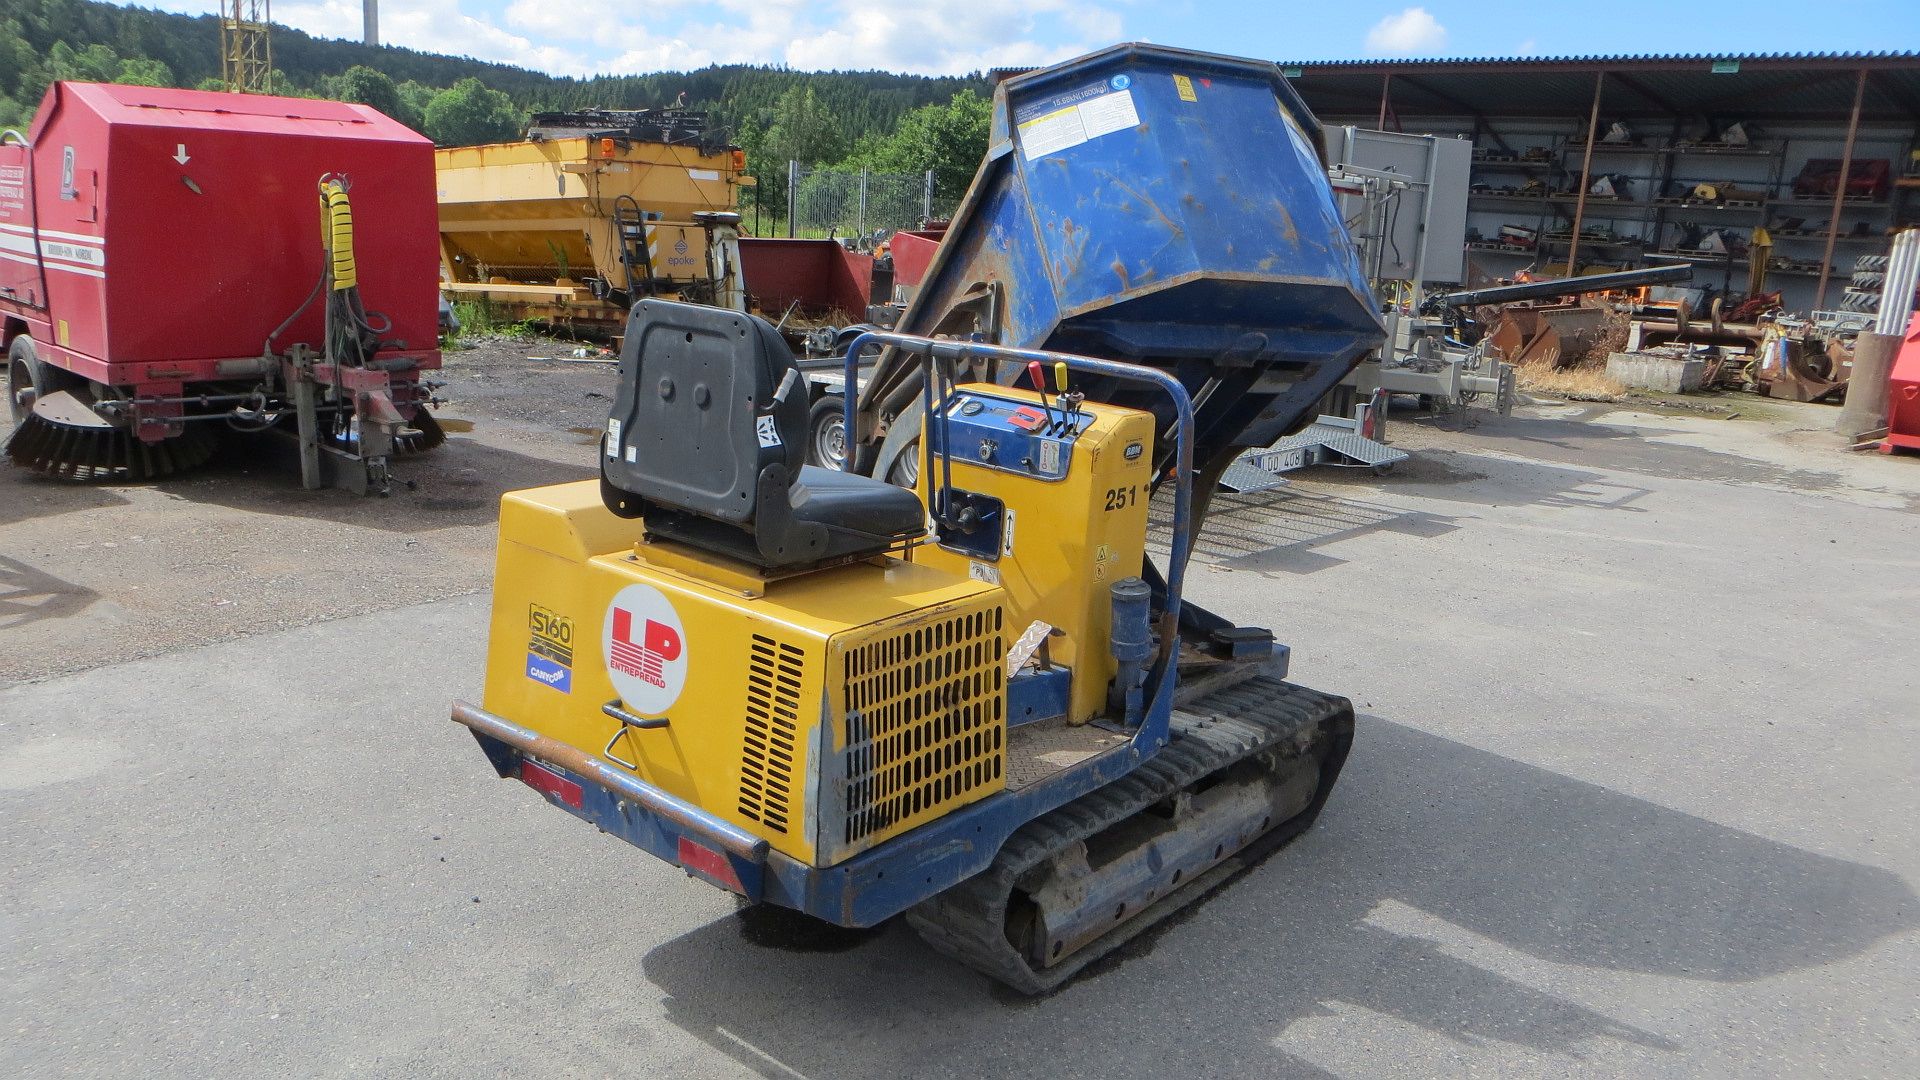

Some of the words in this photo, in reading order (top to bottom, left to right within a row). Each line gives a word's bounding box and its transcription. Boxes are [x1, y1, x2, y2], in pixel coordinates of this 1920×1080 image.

[668, 256, 695, 267] epoke
[1284, 452, 1300, 468] 408
[1104, 485, 1136, 512] 251
[532, 611, 571, 644] S160
[530, 666, 565, 684] CANYCOM
[610, 660, 666, 689] ENTREPRENAD
